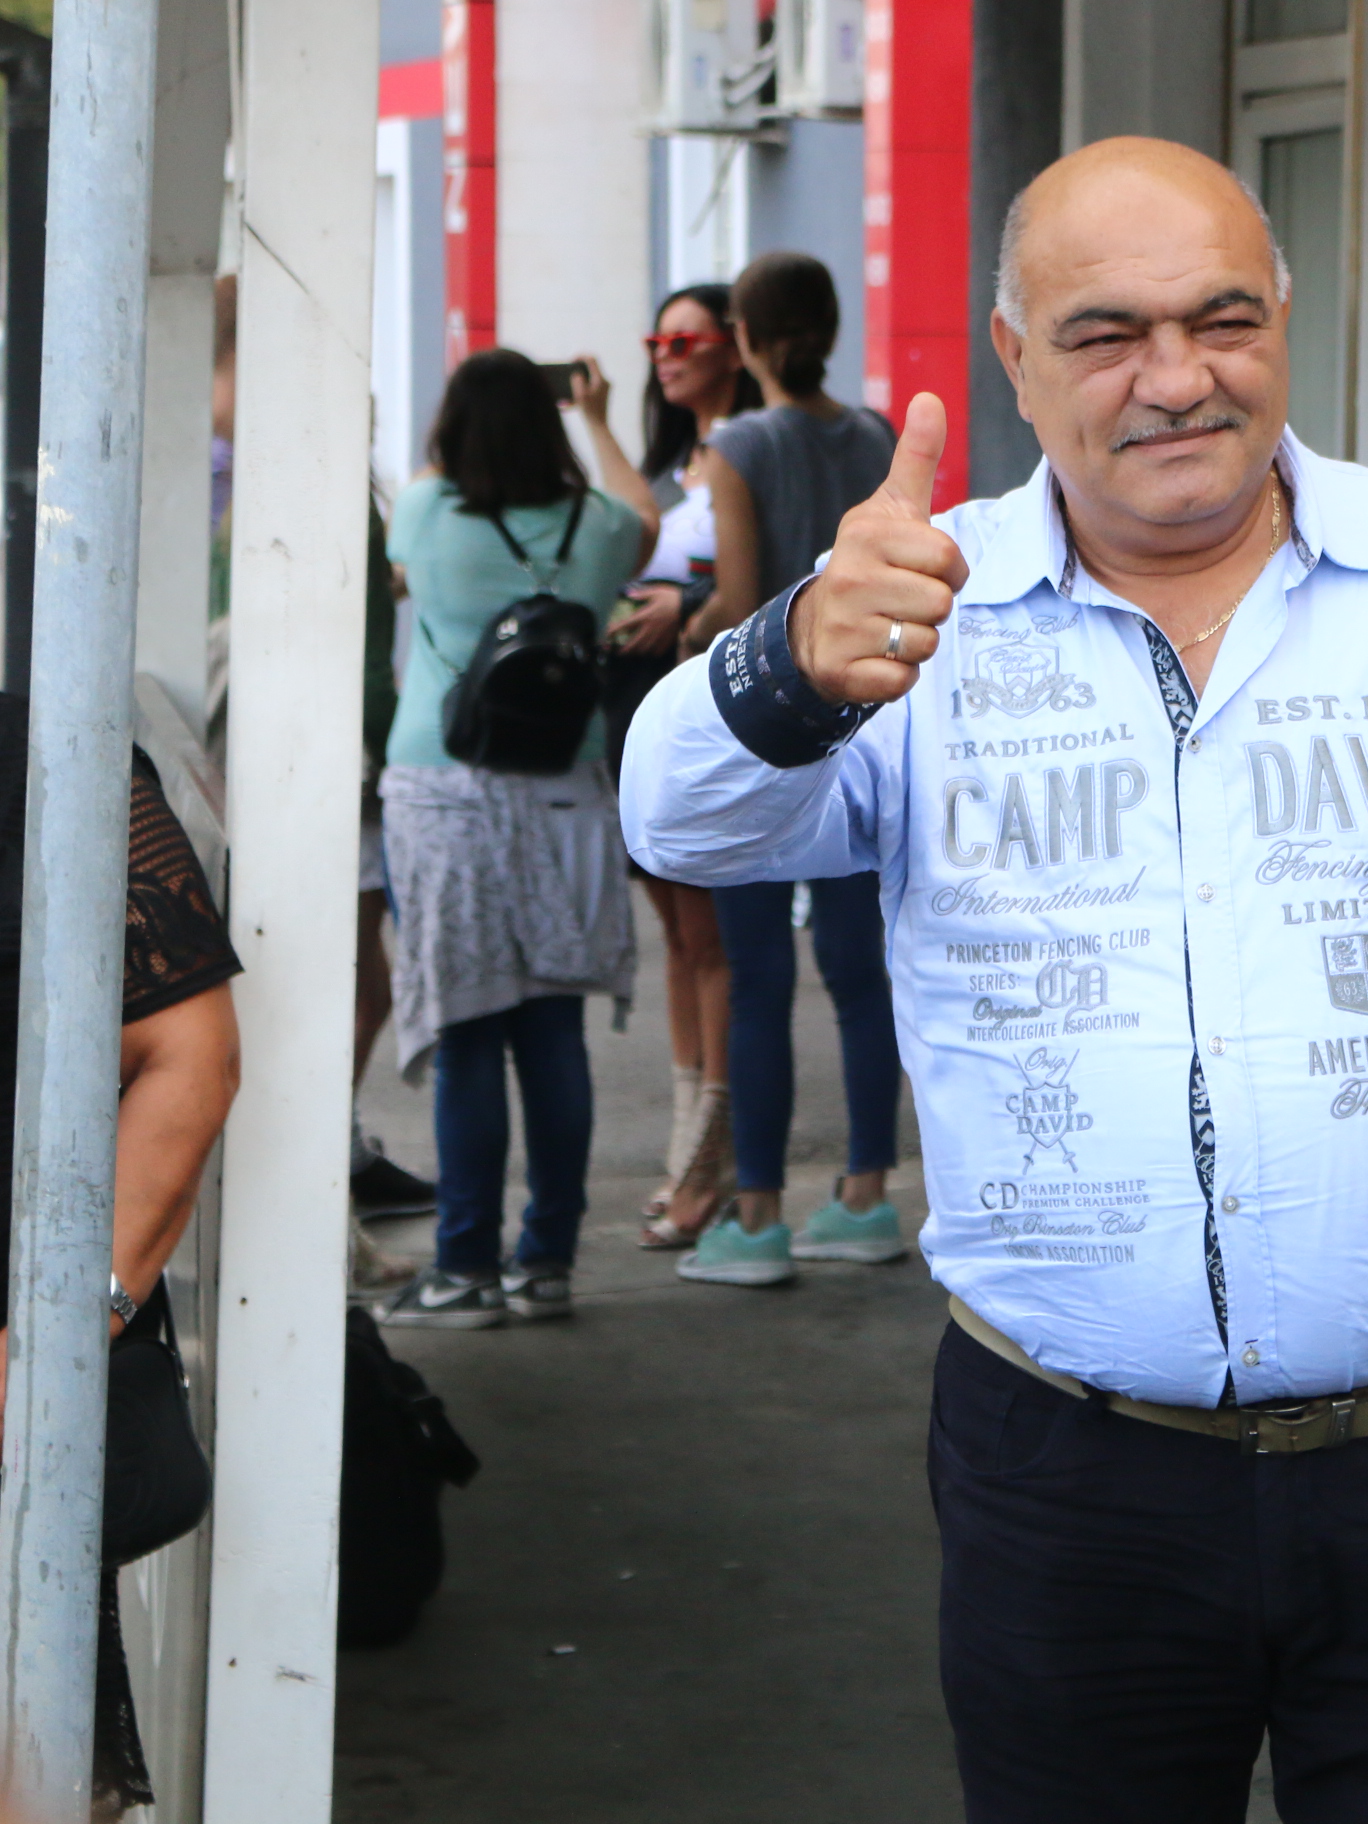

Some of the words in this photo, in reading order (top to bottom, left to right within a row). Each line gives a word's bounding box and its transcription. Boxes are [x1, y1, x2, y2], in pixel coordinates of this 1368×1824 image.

[944, 723, 1134, 760] TRADITIONAL
[942, 758, 1149, 871] CAMP
[931, 865, 1147, 916] International
[946, 941, 1032, 964] PRINCETON
[1039, 934, 1102, 961] FENCING
[1109, 928, 1151, 951] CLUB
[1343, 981, 1358, 996] 63
[966, 1022, 1057, 1042] INTERCOLLEGIATE
[1062, 1012, 1140, 1036] ASSOCIATION
[972, 997, 1044, 1031] Original
[1005, 1092, 1079, 1115] CAMP
[1016, 1112, 1094, 1135] DAVID
[979, 1182, 1019, 1210] CD
[1021, 1179, 1147, 1197] CHAMPIONSHIP
[1022, 1198, 1070, 1209] PREMIUM
[1074, 1194, 1151, 1208] CHALLENGE
[1098, 1211, 1148, 1236] Club
[1046, 1244, 1135, 1264] ASSOCIATION
